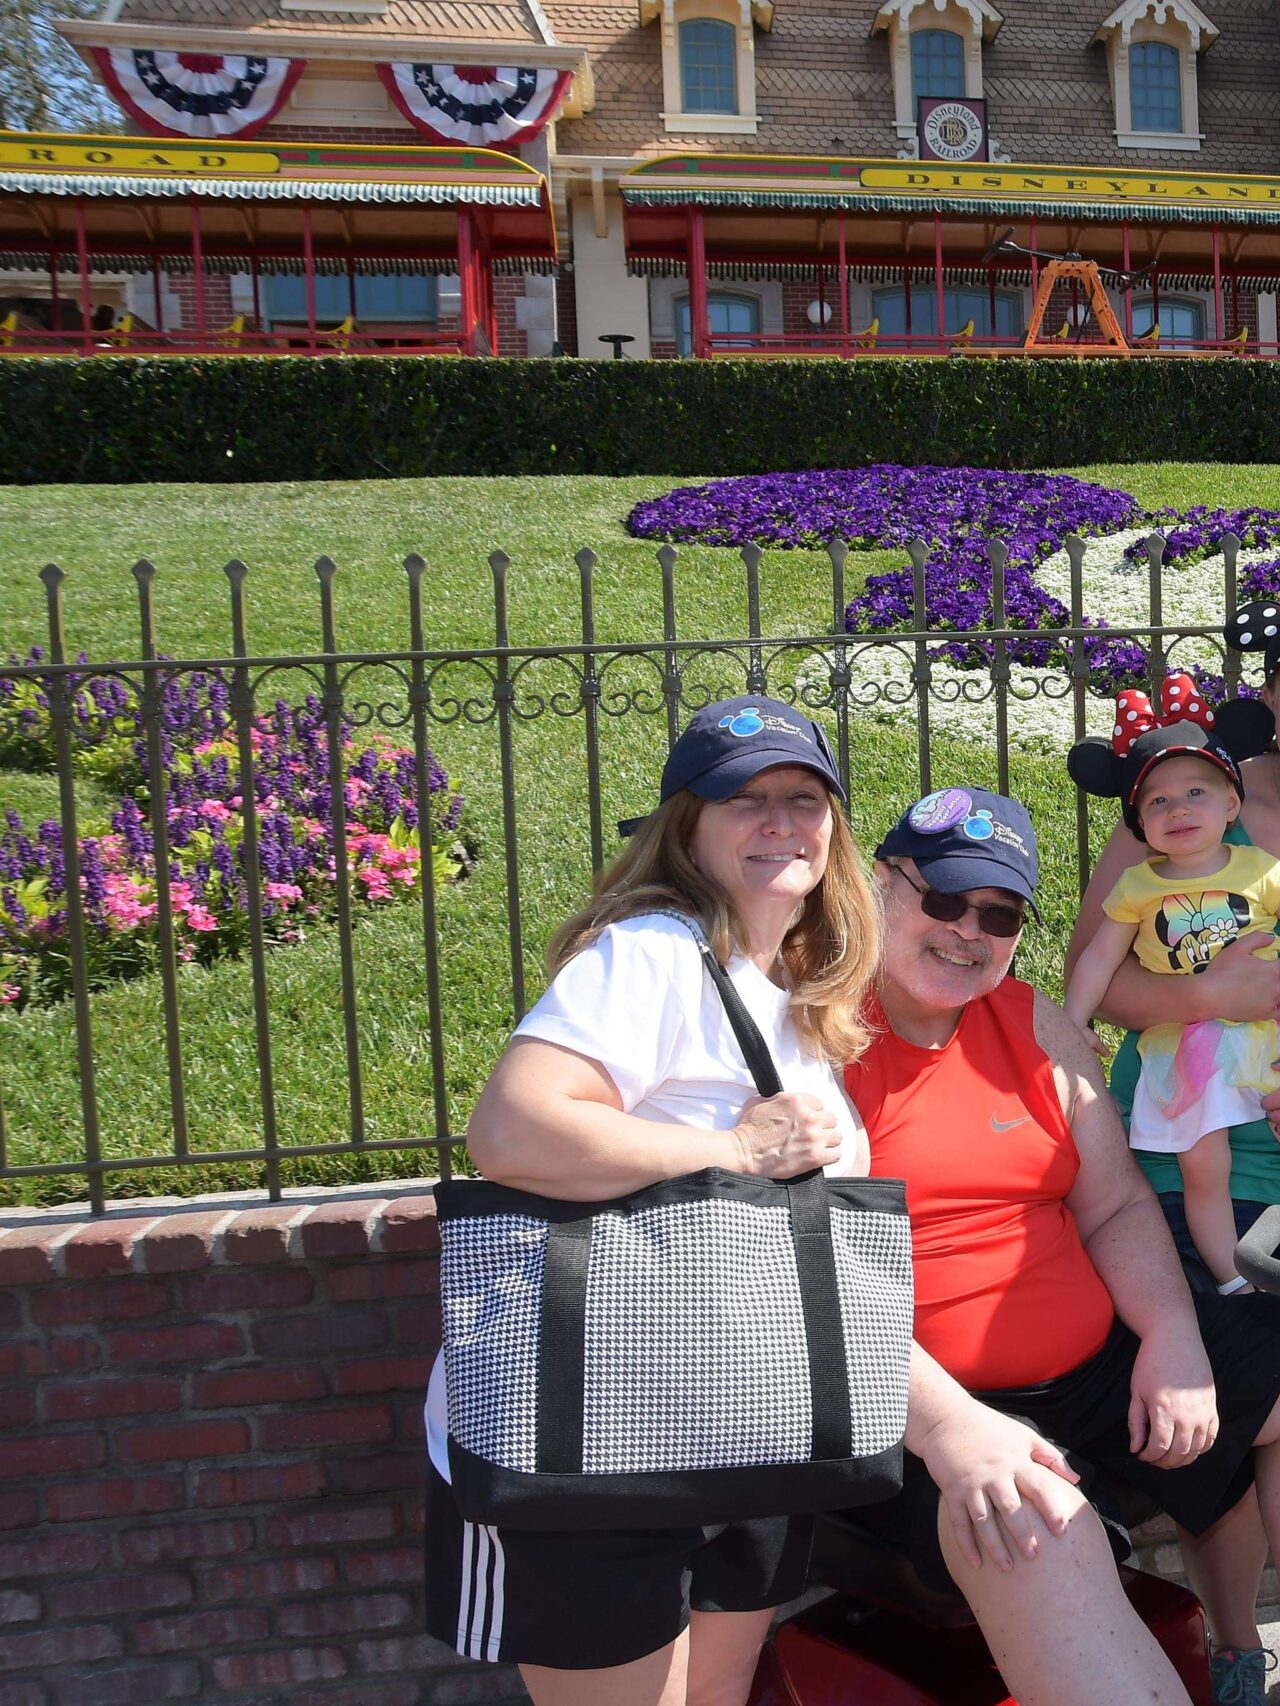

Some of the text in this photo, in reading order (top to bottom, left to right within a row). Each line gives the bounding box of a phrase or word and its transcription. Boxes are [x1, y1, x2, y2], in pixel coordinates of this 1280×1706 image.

[926, 105, 980, 130] Disneyland
[27, 147, 227, 167] ROAD
[930, 137, 977, 159] RAILROAD
[760, 714, 802, 732] Disney
[765, 724, 798, 736] Vacation
[992, 821, 1023, 846] Disney
[994, 833, 1019, 849] Vacation
